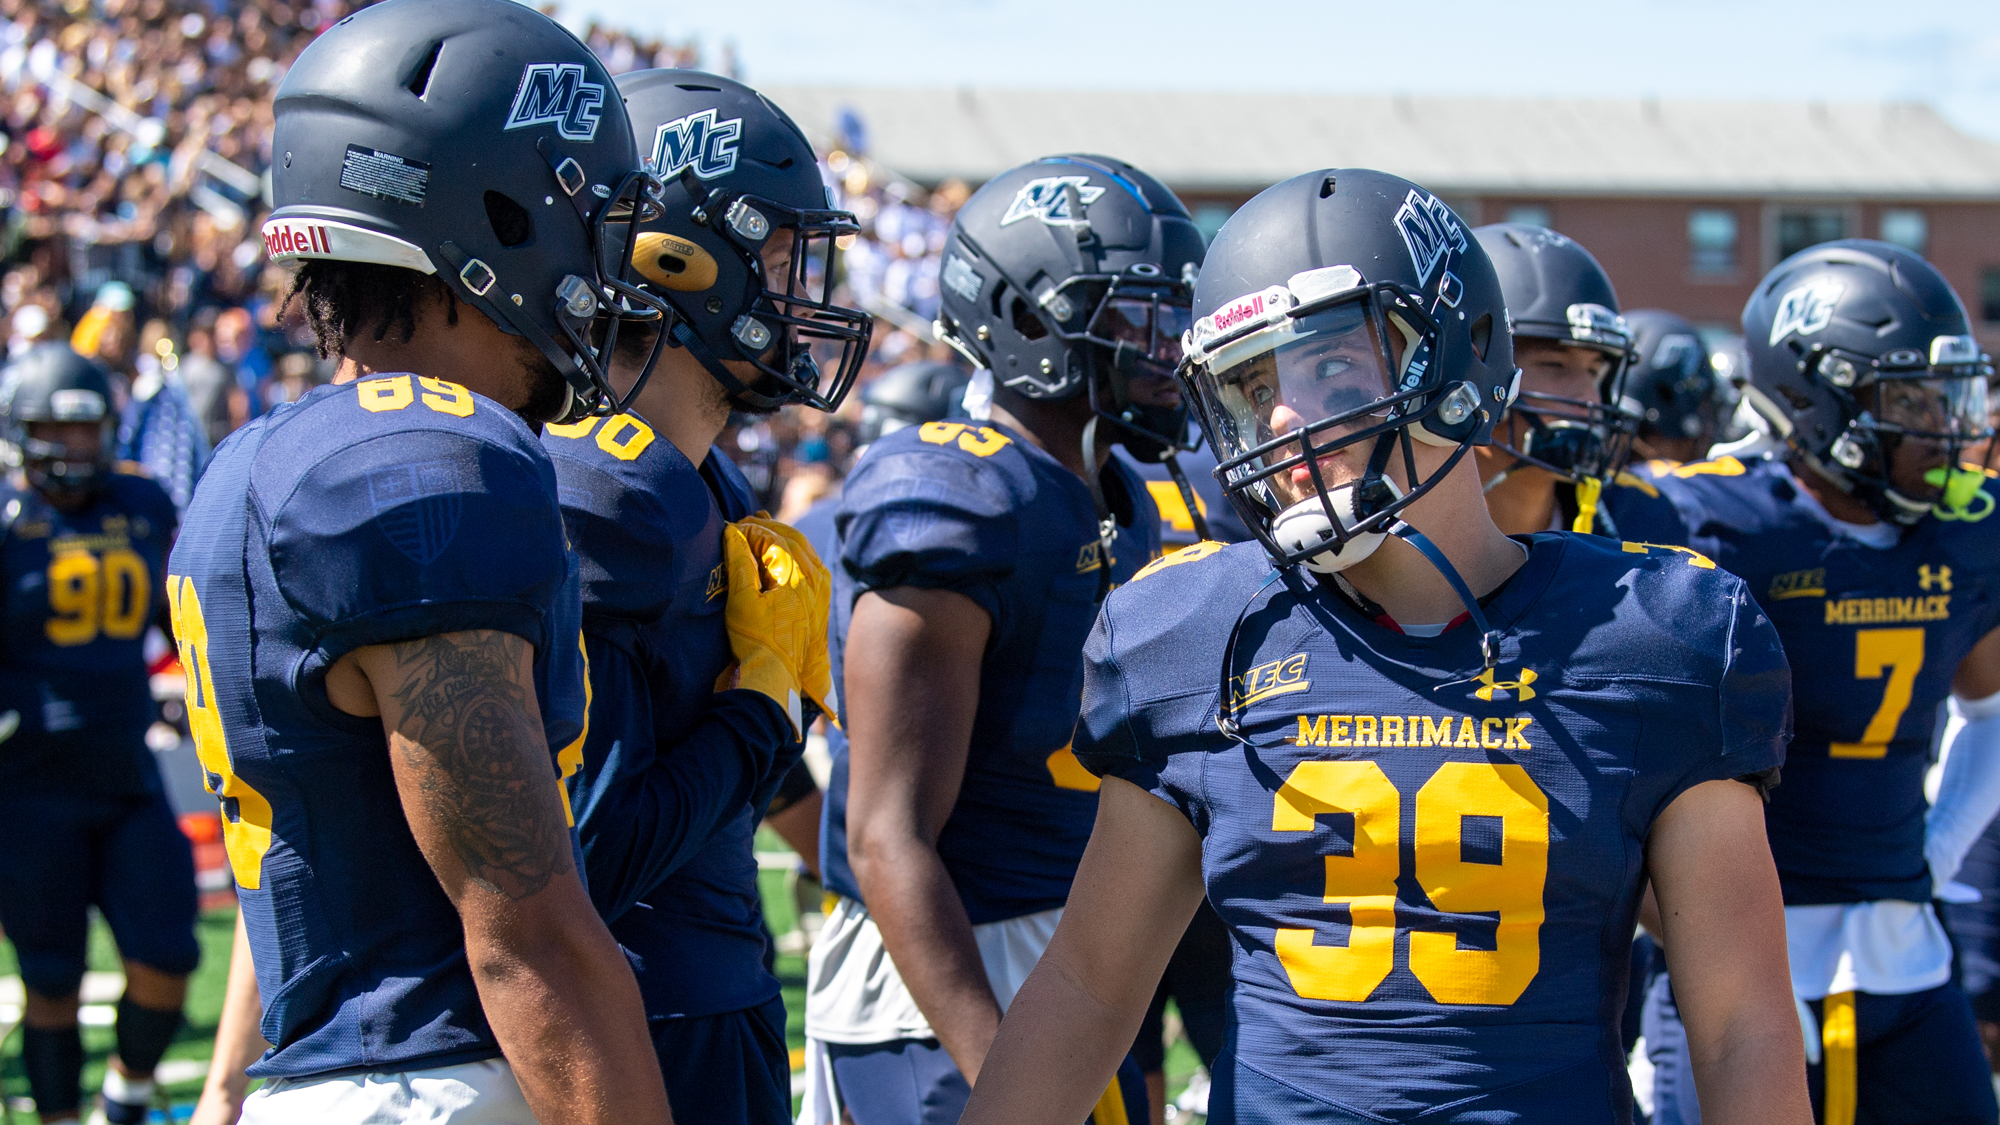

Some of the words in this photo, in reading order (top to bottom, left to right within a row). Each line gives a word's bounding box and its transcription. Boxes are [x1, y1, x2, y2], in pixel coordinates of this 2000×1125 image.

[503, 62, 605, 142] MC
[373, 150, 404, 164] WARNING
[651, 107, 743, 183] MC
[1394, 188, 1468, 288] MC
[1214, 295, 1264, 331] Riddell
[46, 551, 149, 647] 90
[1825, 595, 1951, 624] MERRIMACK
[1228, 653, 1307, 706] NEC
[1829, 627, 1926, 760] 7
[1296, 714, 1533, 749] MERRIMACK
[1271, 760, 1550, 1005] 39
